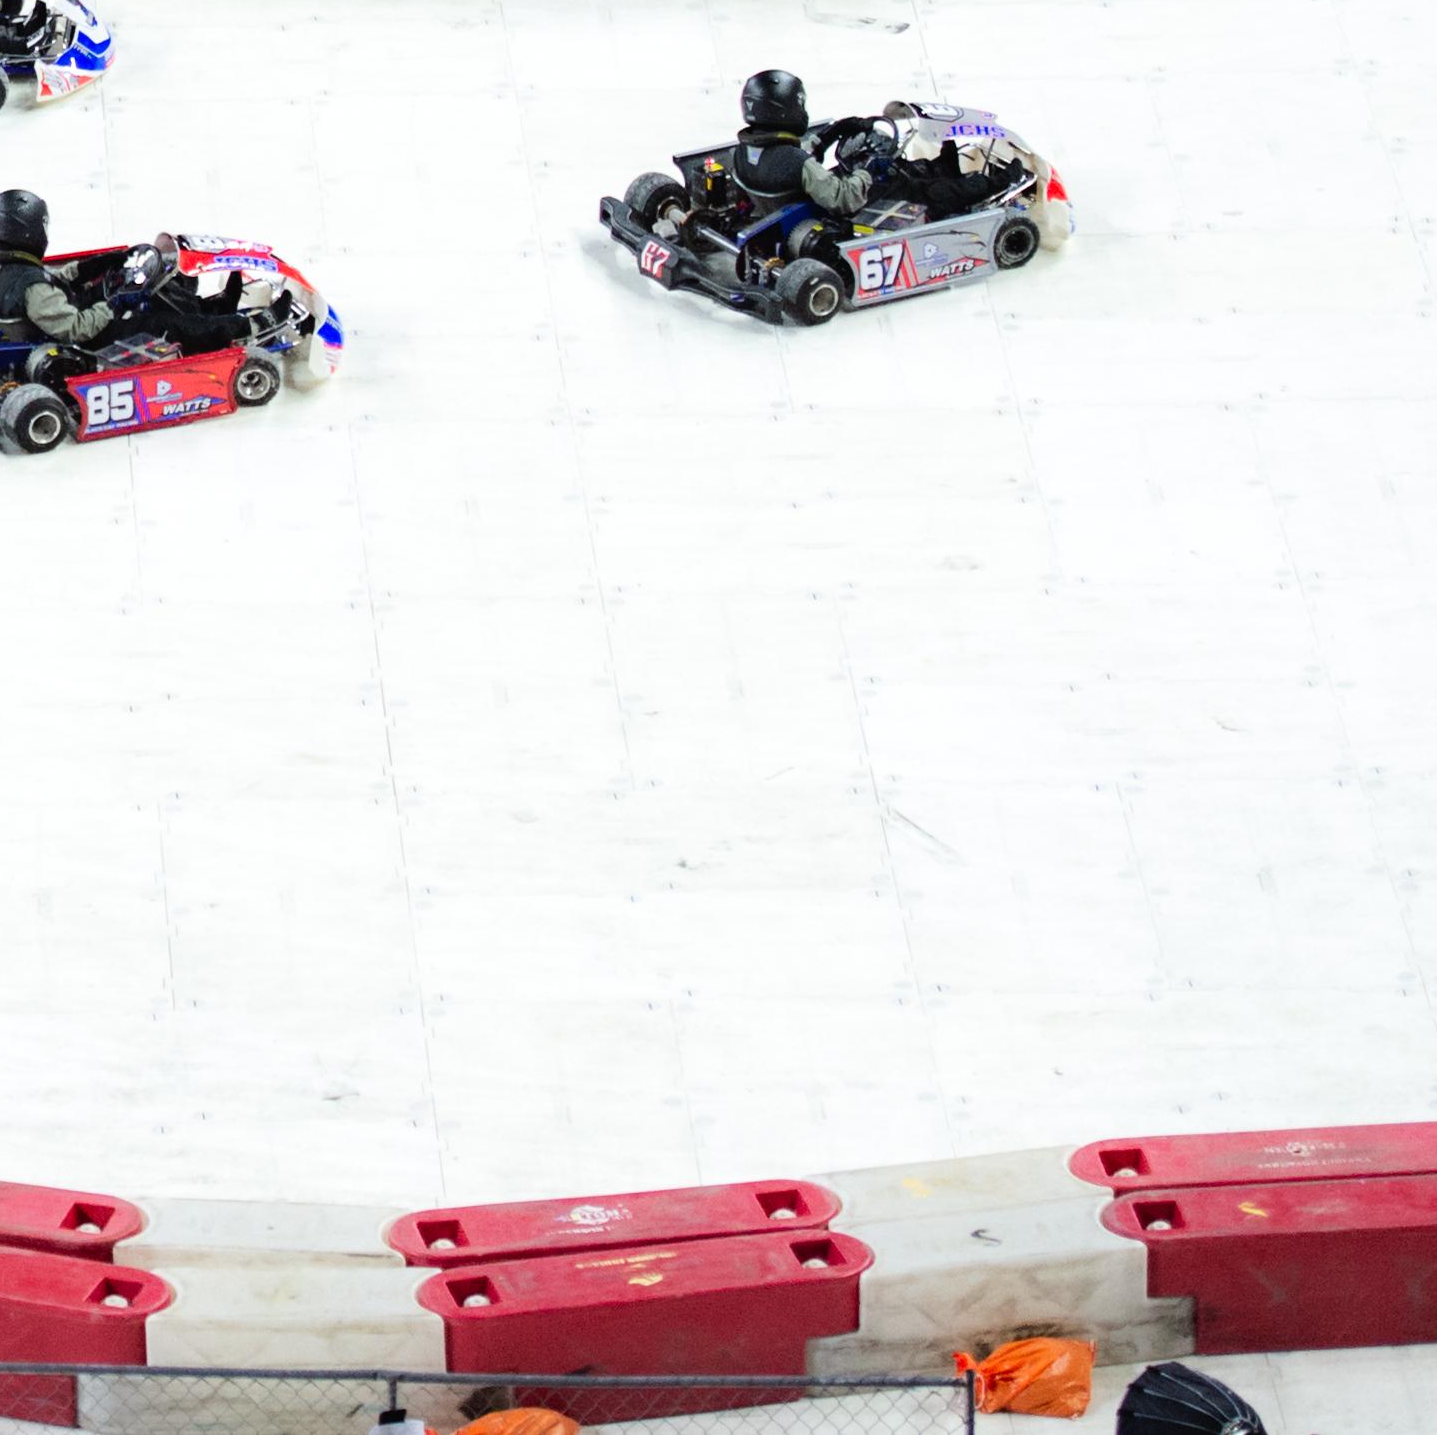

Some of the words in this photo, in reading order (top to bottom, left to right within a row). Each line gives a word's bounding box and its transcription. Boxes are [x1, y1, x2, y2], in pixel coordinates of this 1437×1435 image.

[945, 125, 1006, 138] JCHS
[858, 242, 906, 291] 67
[929, 259, 975, 280] WATTS
[85, 379, 135, 426] 85
[162, 397, 212, 416] WATTS
